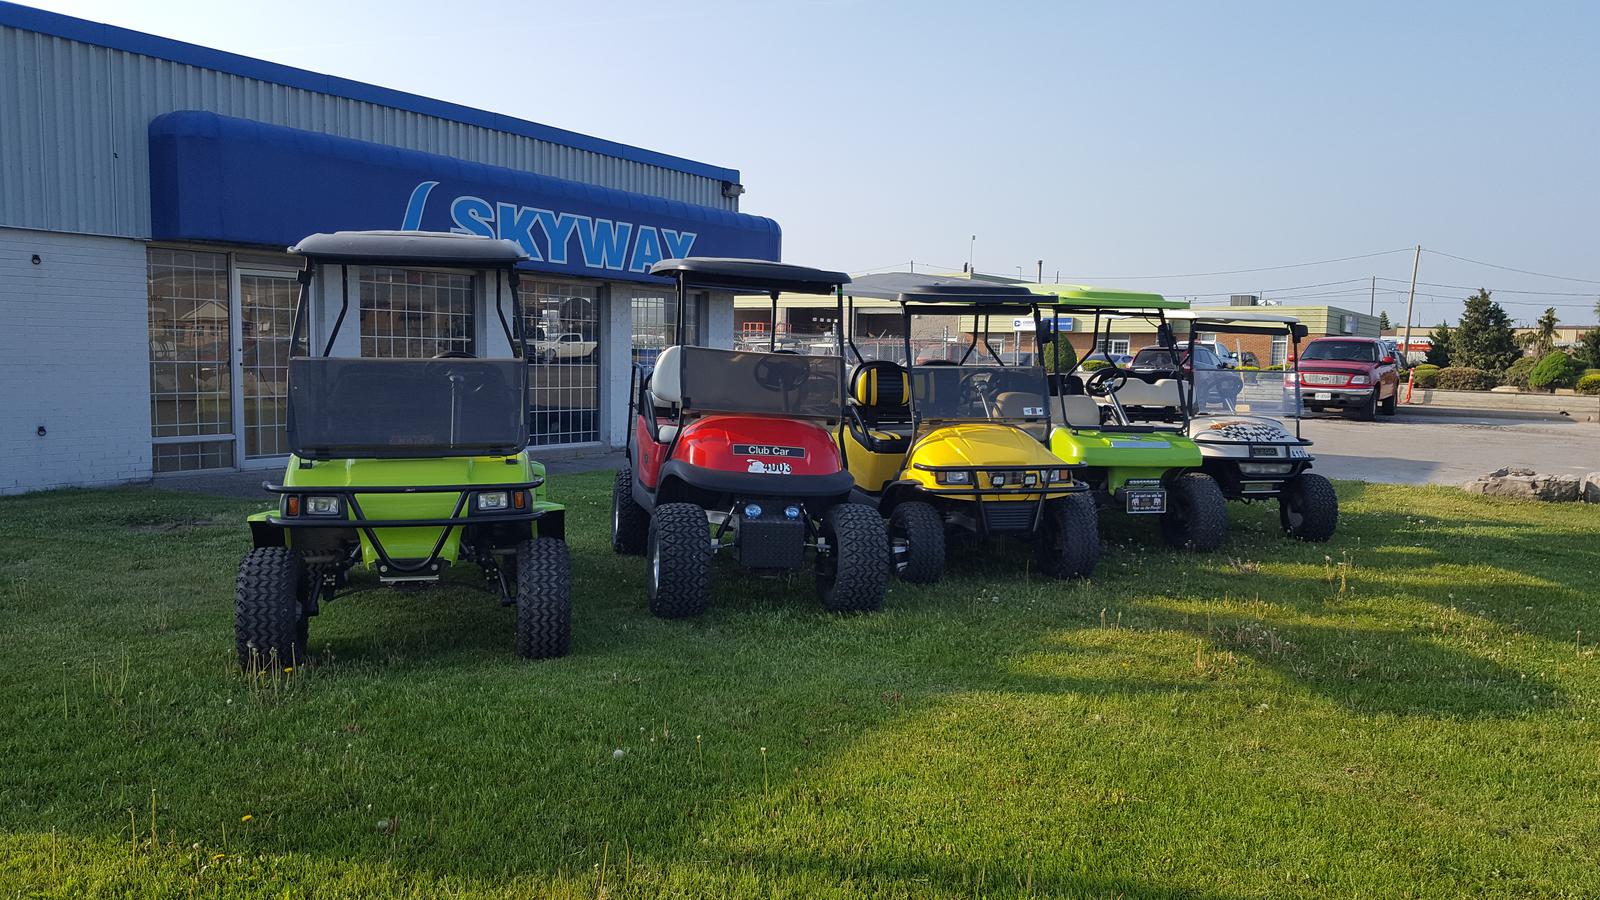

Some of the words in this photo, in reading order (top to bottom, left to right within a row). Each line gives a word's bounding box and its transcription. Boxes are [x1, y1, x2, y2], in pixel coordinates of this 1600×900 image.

[450, 195, 697, 272] SKYWAY
[748, 446, 770, 454] Club
[772, 447, 790, 455] Car
